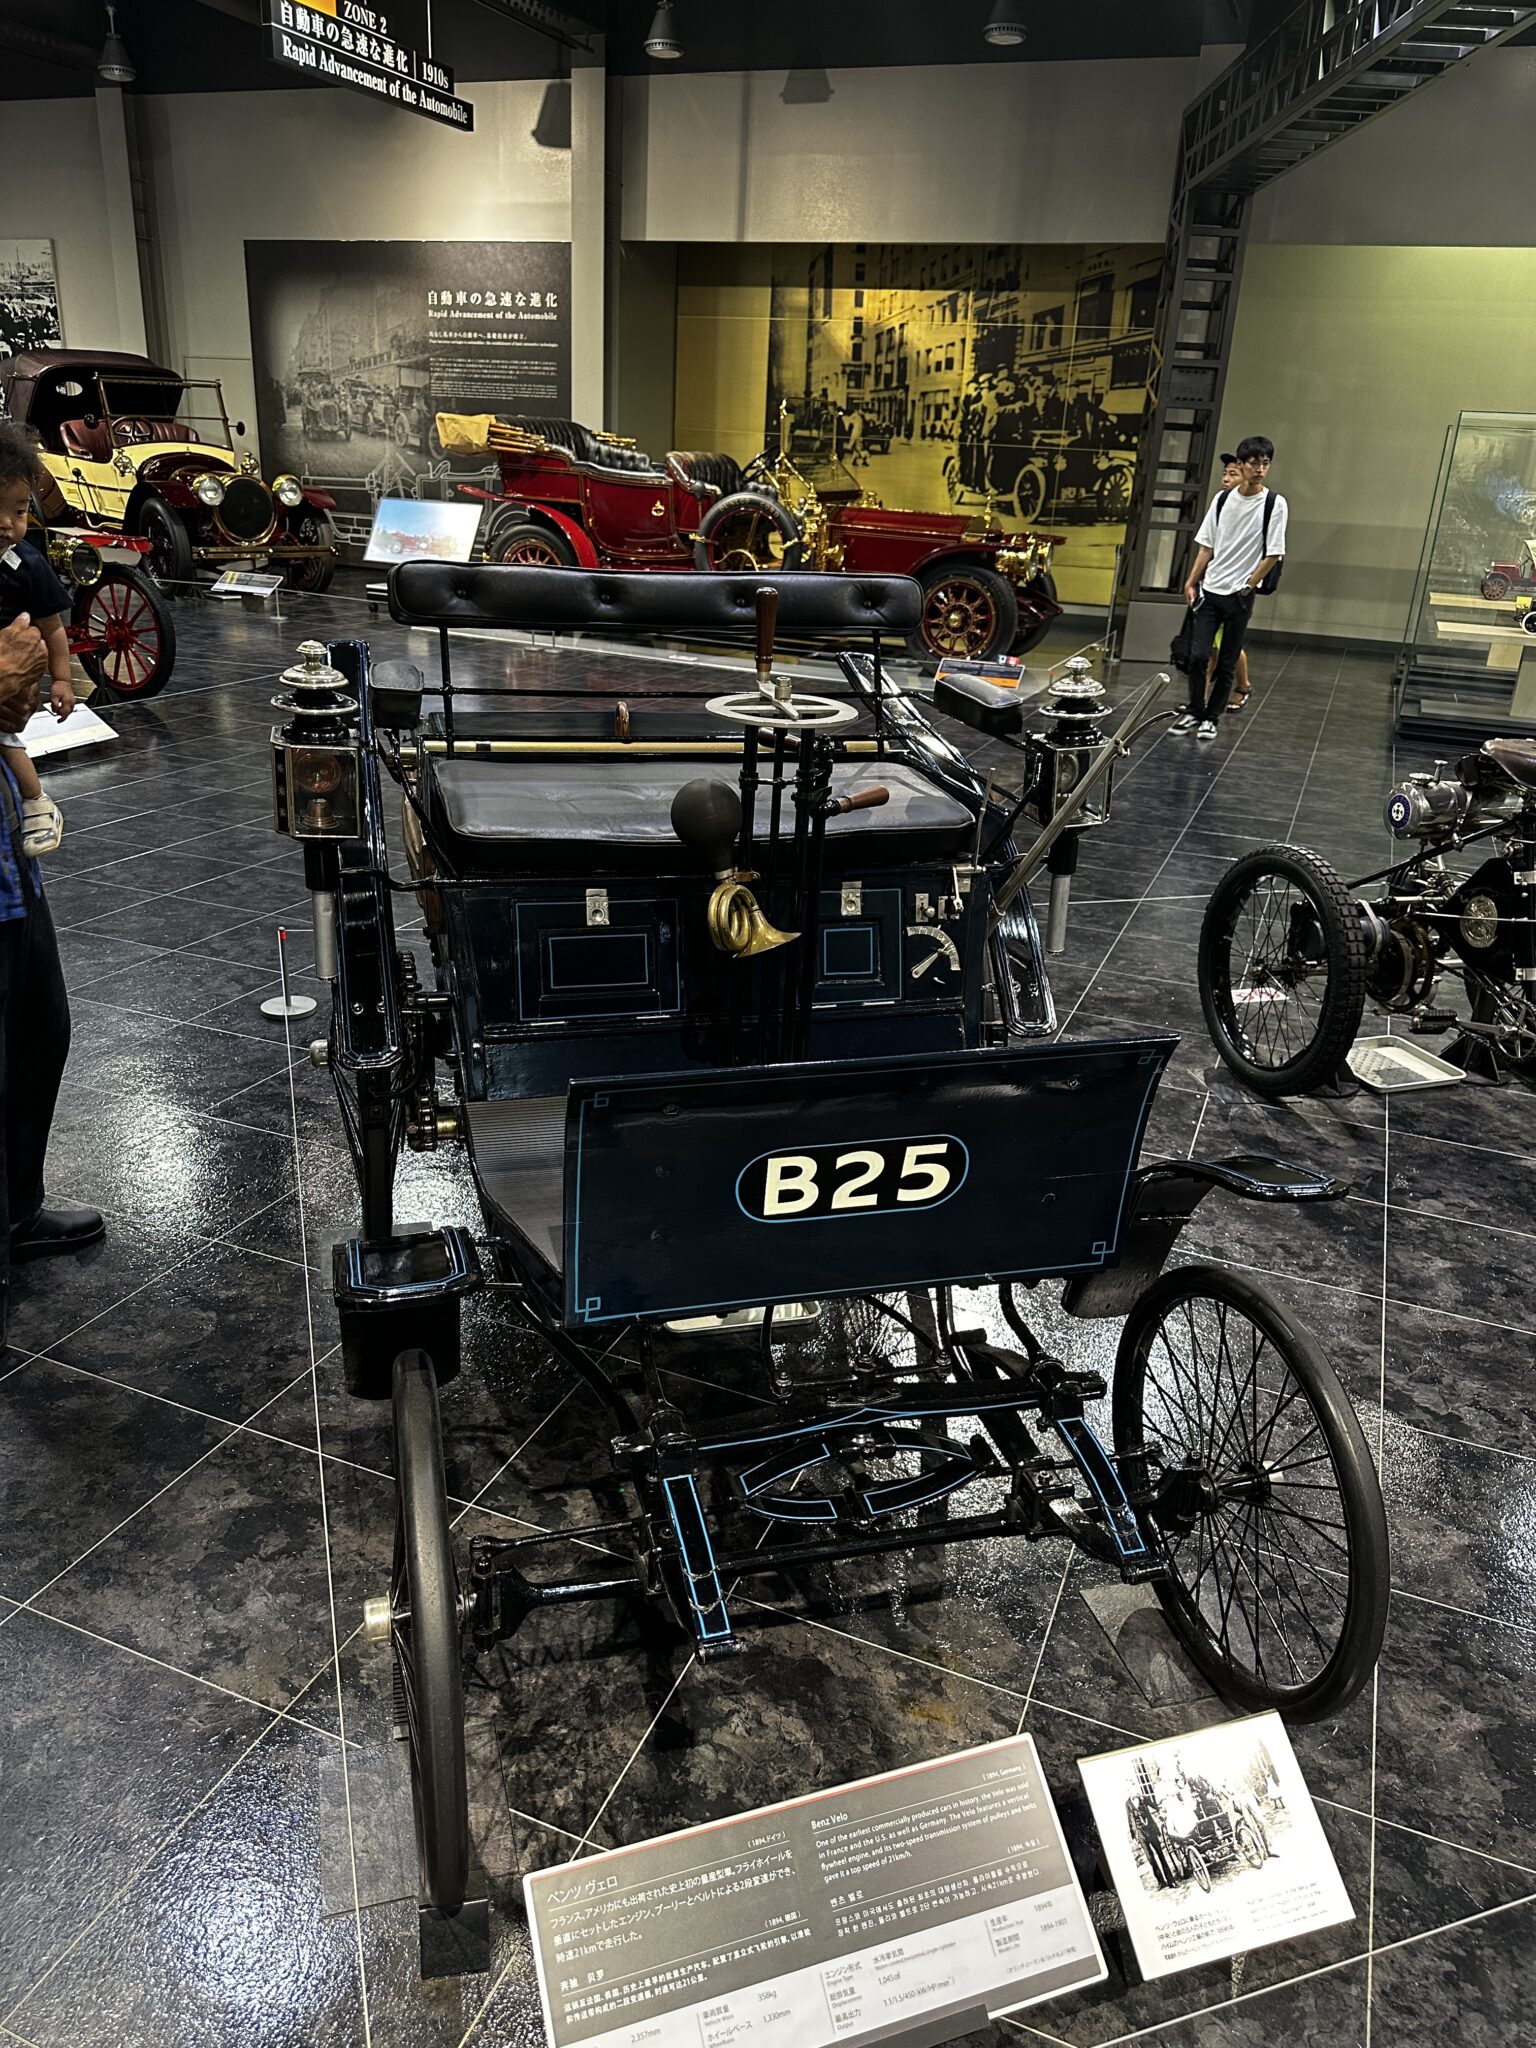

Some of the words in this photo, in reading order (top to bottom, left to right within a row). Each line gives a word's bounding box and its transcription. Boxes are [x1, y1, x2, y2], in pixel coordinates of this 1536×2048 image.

[344, 1, 376, 29] ZONE
[380, 17, 387, 34] 2
[281, 2, 408, 73] 自動車の急速な進化
[282, 34, 316, 67] Rapid
[320, 50, 388, 94] Advancement
[390, 81, 402, 99] of
[402, 86, 417, 105] the
[420, 91, 468, 124] Automobile
[422, 62, 449, 89] 1910s
[428, 290, 558, 308] 自動車の急速な進化
[428, 310, 448, 319] Rapid
[450, 310, 494, 319] Advancement
[495, 311, 504, 319] of
[505, 311, 516, 320] the
[519, 311, 558, 321] Automobile
[763, 1143, 951, 1216] B25
[811, 1819, 830, 1829] Benz
[830, 1813, 848, 1823] Velo
[816, 1840, 828, 1848] One
[849, 1827, 870, 1838] earliest
[872, 1816, 910, 1831] commercially
[912, 1807, 939, 1822] produced
[992, 1789, 1004, 1797] Velo
[1017, 1781, 1029, 1790] sold
[827, 1846, 848, 1856] France
[850, 1841, 861, 1850] and
[875, 1834, 887, 1842] U.S.
[897, 1827, 910, 1836] well
[962, 1809, 975, 1817] Velo
[977, 1802, 1001, 1813] features
[1007, 1792, 1029, 1804] vertical
[821, 1857, 847, 1871] flywheel
[848, 1852, 870, 1862] engine,
[872, 1846, 883, 1855] and
[893, 1834, 923, 1849] two-speed
[924, 1825, 961, 1840] transmission
[962, 1819, 981, 1830] system
[983, 1815, 988, 1823] of
[990, 1811, 1010, 1822] pulleys
[1011, 1806, 1021, 1814] and
[1022, 1803, 1036, 1811] belts
[824, 1873, 839, 1883] gave
[862, 1859, 880, 1871] speed
[888, 1851, 912, 1863] 21km/h.
[547, 1886, 581, 1903] ベンツ
[585, 1876, 617, 1895] ヴェロ
[556, 1931, 642, 1963] 時速21kmで走行した。
[825, 1962, 862, 1979] エンジン形式
[708, 2021, 752, 2041] ホイールベース
